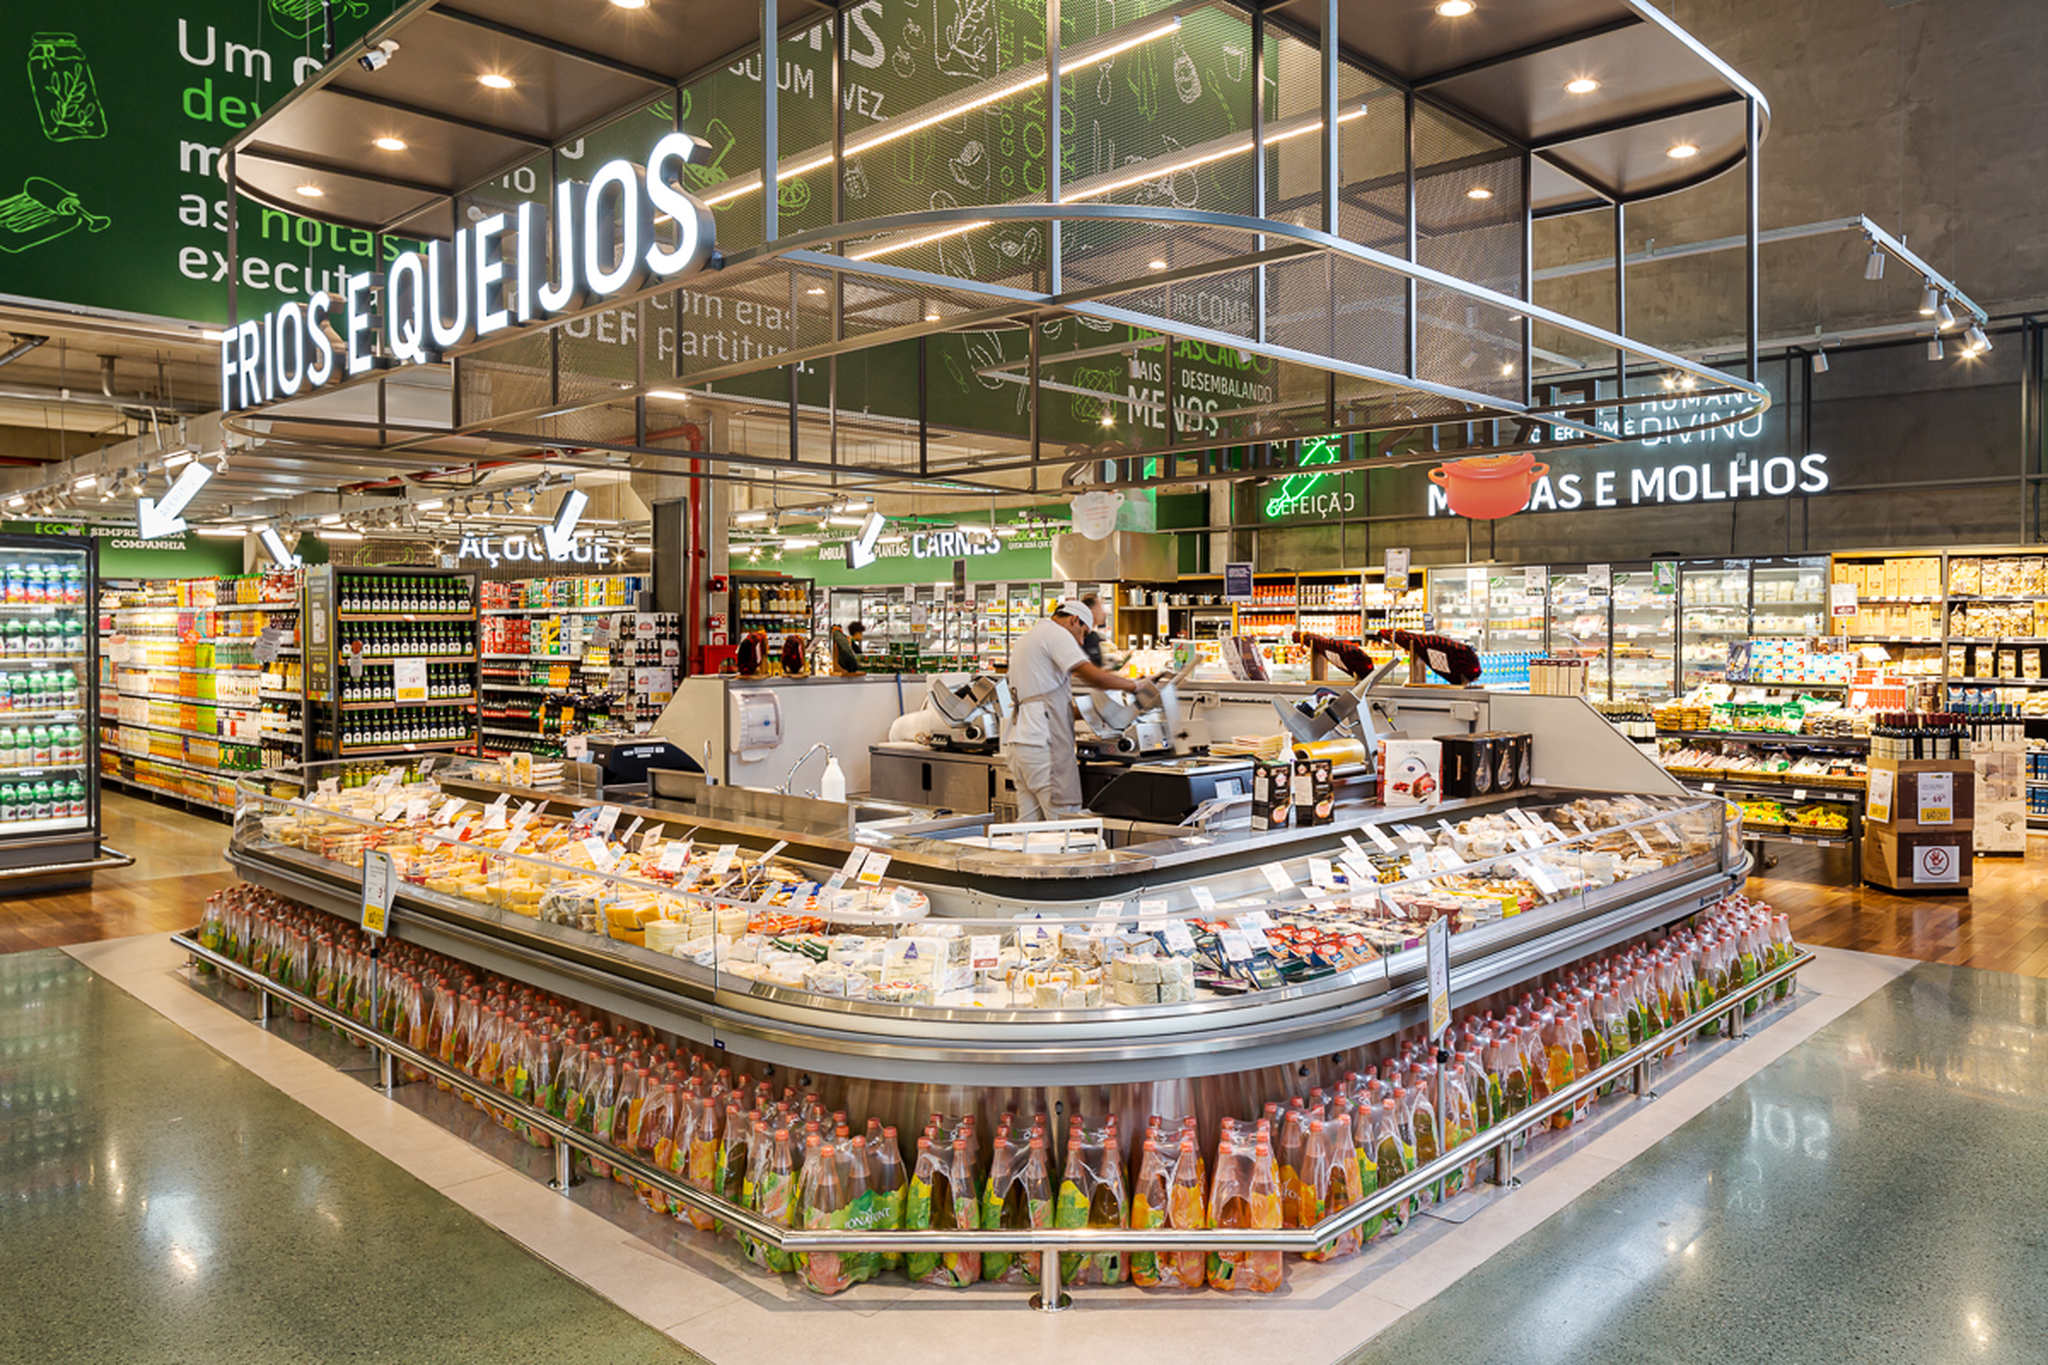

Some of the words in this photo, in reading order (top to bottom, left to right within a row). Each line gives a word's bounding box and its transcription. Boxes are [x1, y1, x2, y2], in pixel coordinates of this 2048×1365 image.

[178, 18, 272, 83] Um
[178, 192, 240, 234] as
[261, 207, 402, 262] notas
[220, 290, 334, 412] FRIOS
[347, 270, 372, 377] E
[387, 131, 706, 364] QUEIJOS
[1181, 368, 1273, 404] DESEMBALANDO
[1641, 403, 1764, 446] DIVINO
[1595, 471, 1617, 506] E
[1631, 453, 1830, 505] MOLHOS
[458, 531, 611, 569] AÇOUUE
